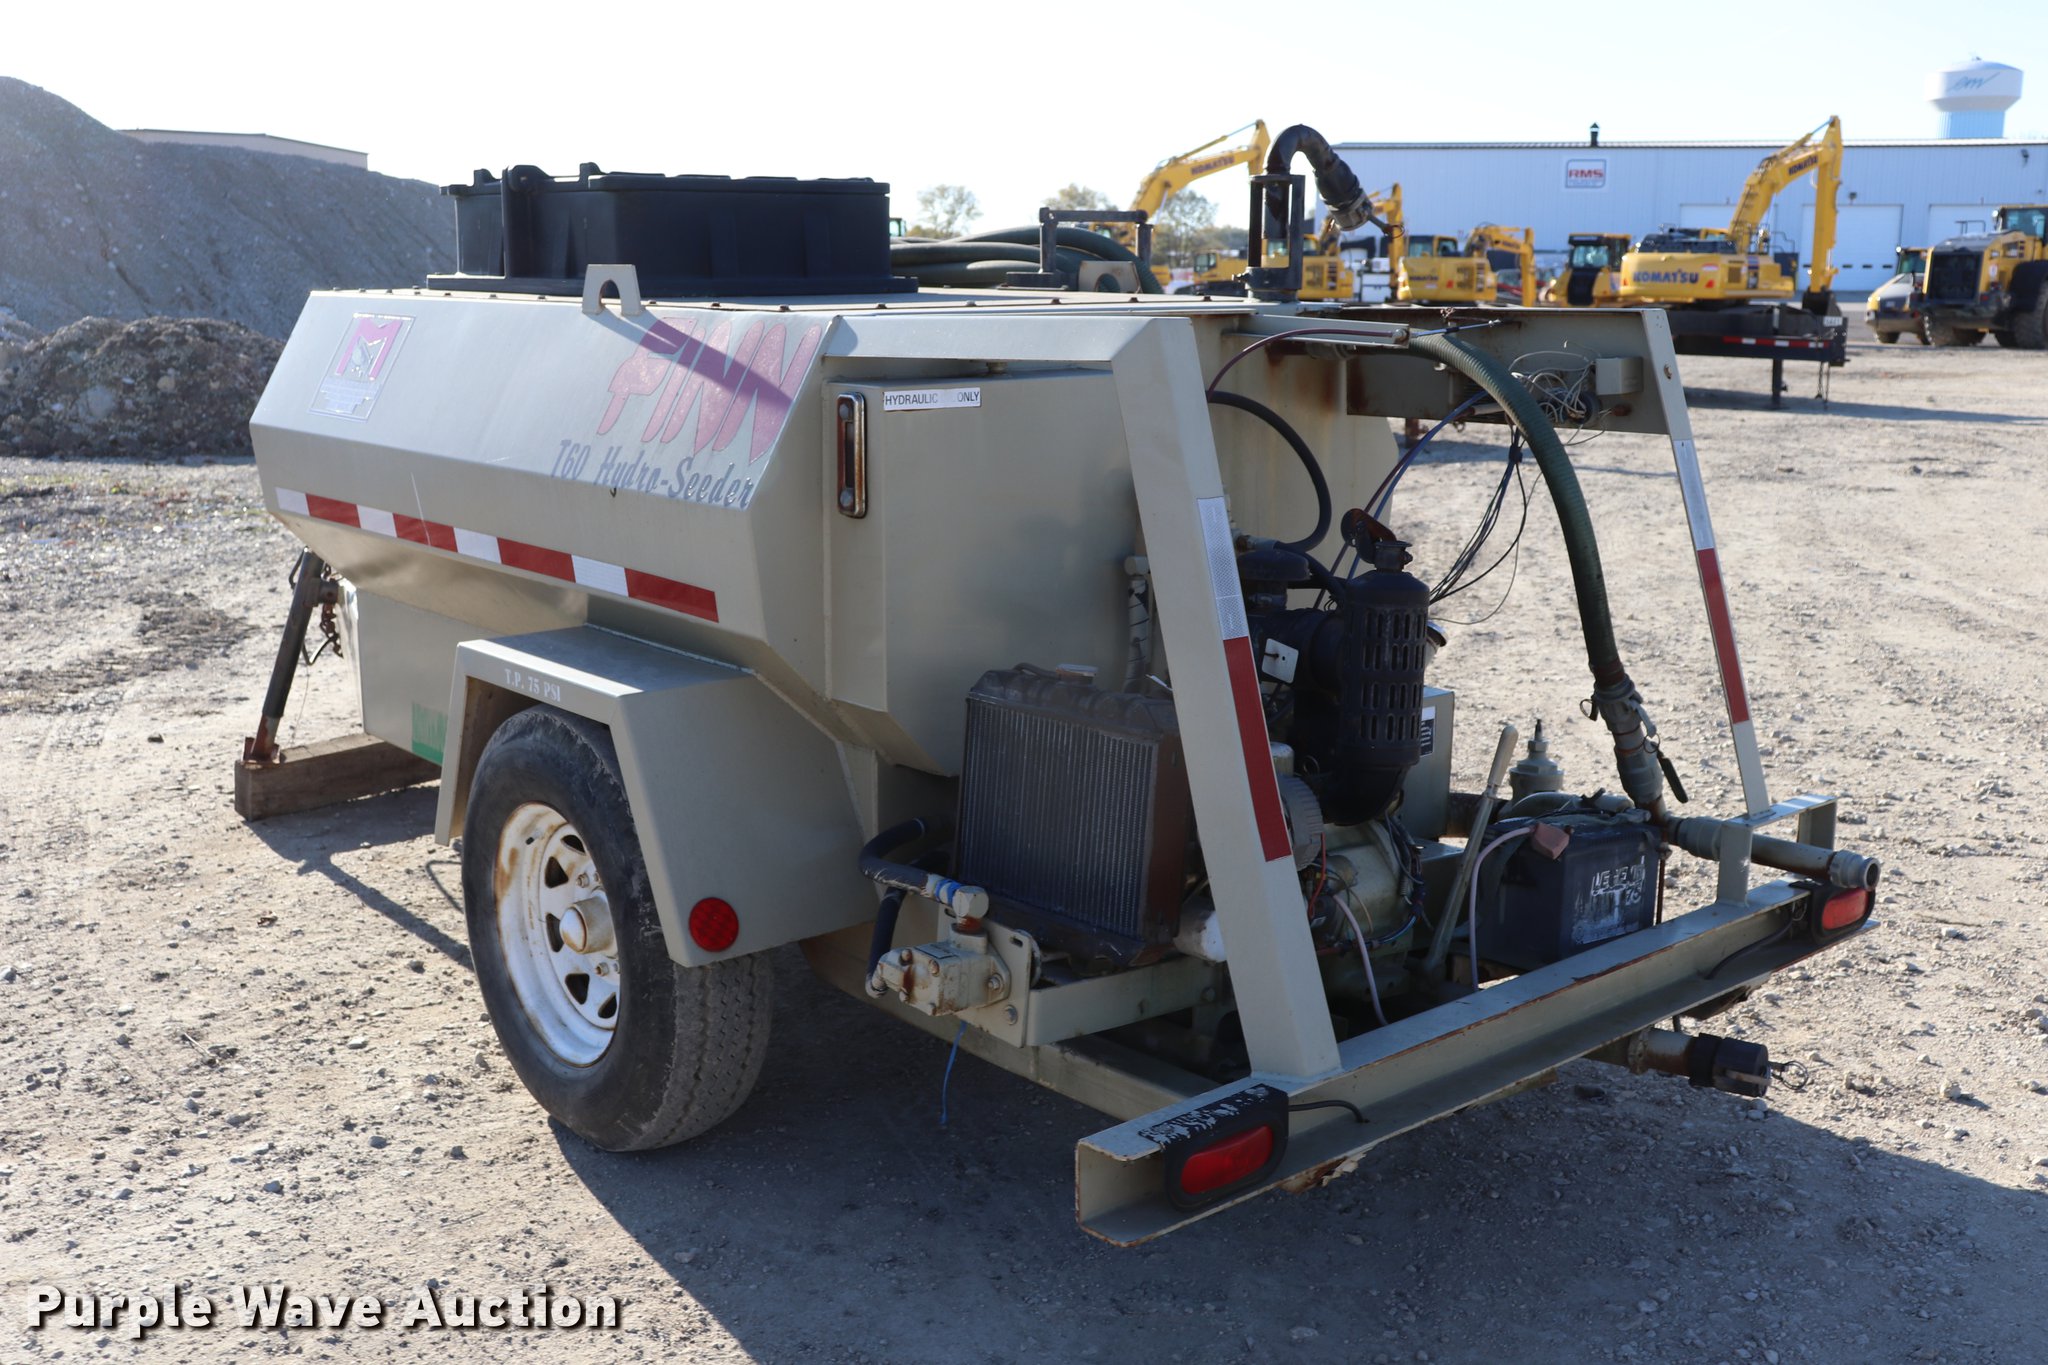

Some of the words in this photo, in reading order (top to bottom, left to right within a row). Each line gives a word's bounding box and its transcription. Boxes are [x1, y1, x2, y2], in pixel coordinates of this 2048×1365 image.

[1568, 169, 1604, 178] RMS
[1788, 155, 1818, 176] KOMATSU
[1633, 269, 1699, 284] KOMATSU
[596, 316, 822, 466] FINN
[885, 393, 938, 406] HYDRAULIC
[957, 391, 980, 403] ONLY
[551, 439, 591, 479] T60
[594, 445, 755, 510] Hydro-Seeder
[504, 668, 525, 689] T.P.
[527, 676, 540, 695] 75
[544, 681, 561, 702] PSI
